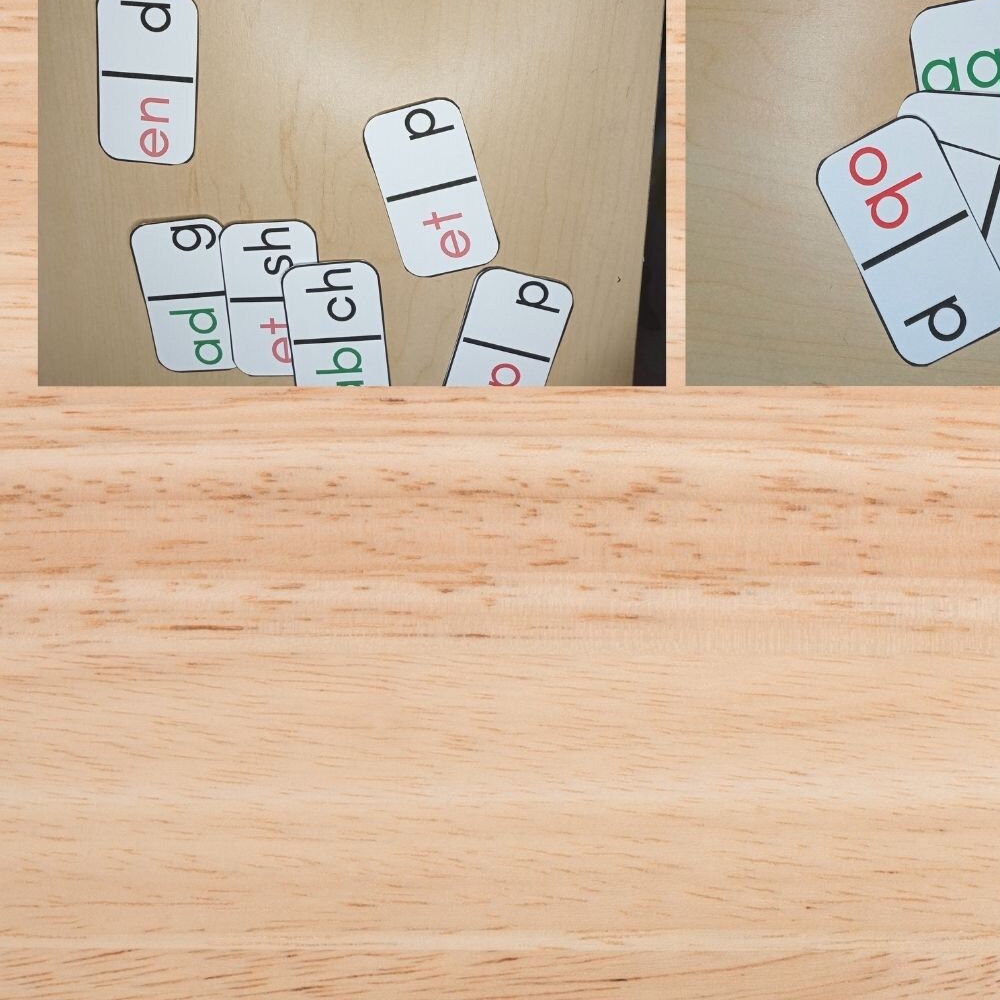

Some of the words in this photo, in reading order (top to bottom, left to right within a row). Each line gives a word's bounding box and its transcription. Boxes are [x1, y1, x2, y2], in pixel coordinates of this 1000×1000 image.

[120, 0, 172, 33] d
[139, 97, 169, 158] en
[404, 108, 454, 141] p
[170, 222, 216, 252] g
[242, 227, 293, 277] sh
[423, 211, 471, 258] et
[305, 267, 357, 322] ch
[516, 280, 561, 314] p
[169, 308, 223, 365] ad
